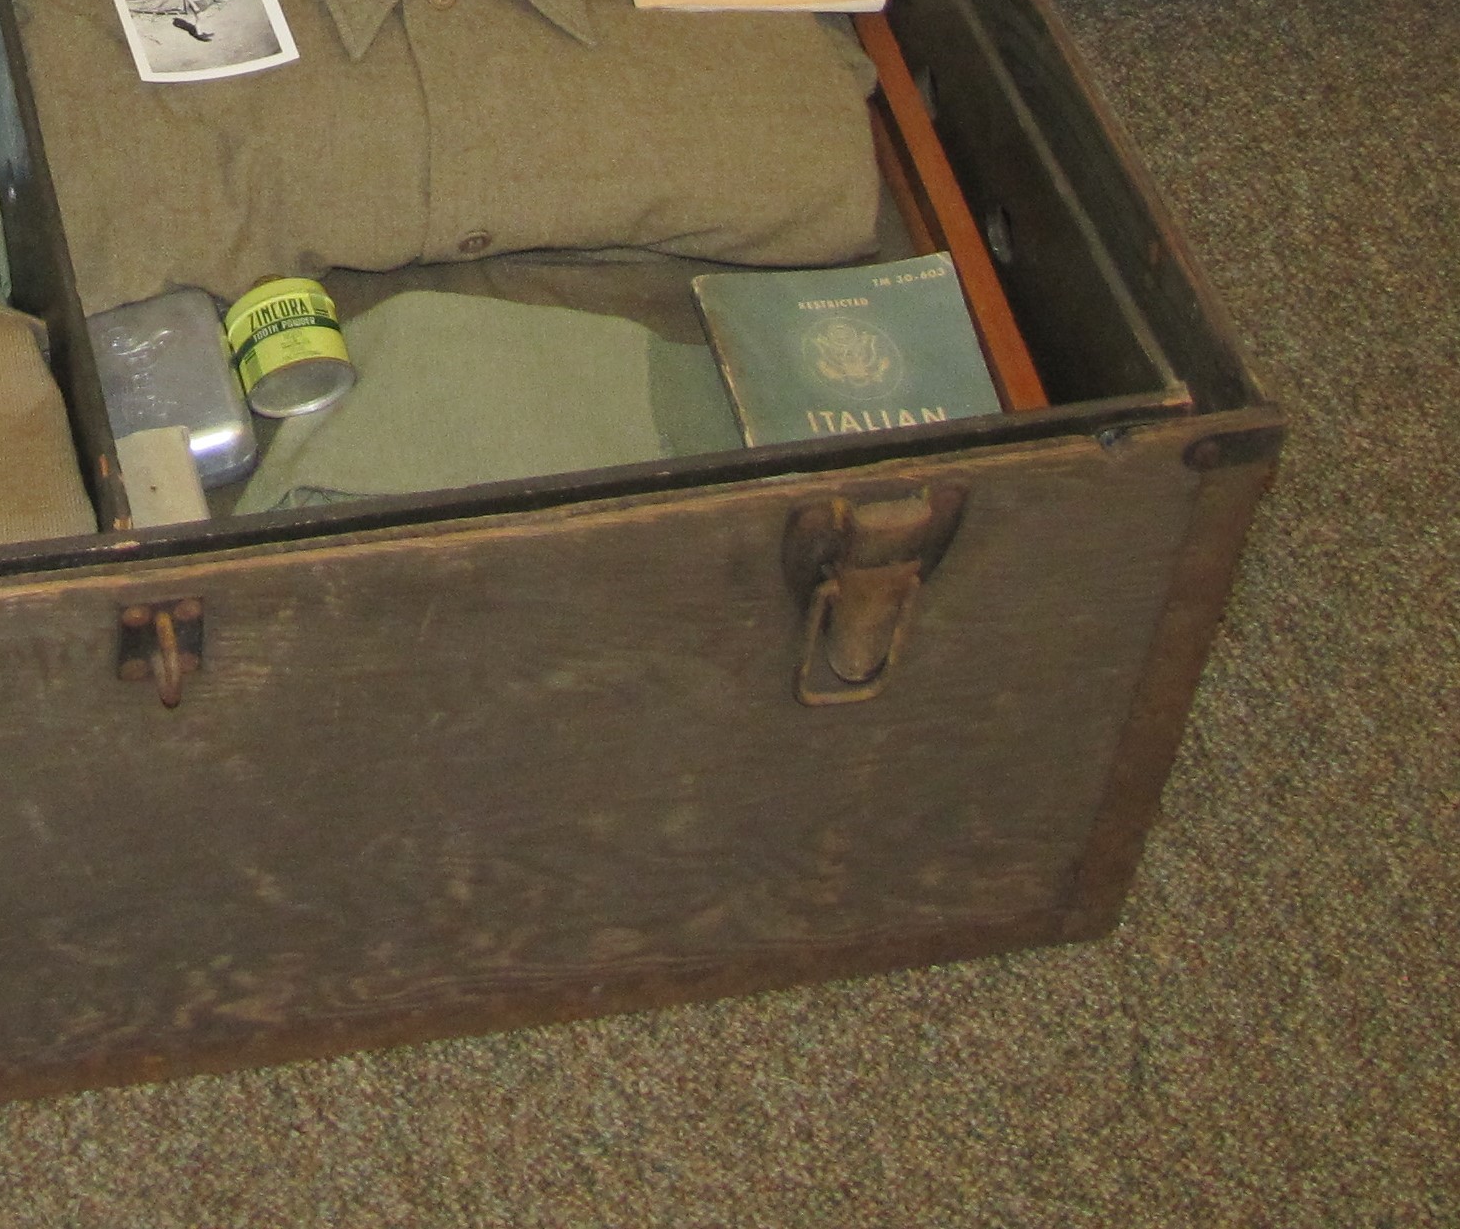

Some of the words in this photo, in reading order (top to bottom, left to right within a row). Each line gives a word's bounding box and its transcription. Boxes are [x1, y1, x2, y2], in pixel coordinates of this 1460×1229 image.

[247, 297, 310, 333] ZINCORA
[798, 297, 869, 310] RESTRICTED
[253, 324, 280, 343] TOOTH
[280, 316, 316, 330] POWDER
[806, 406, 948, 434] ITALIAN
